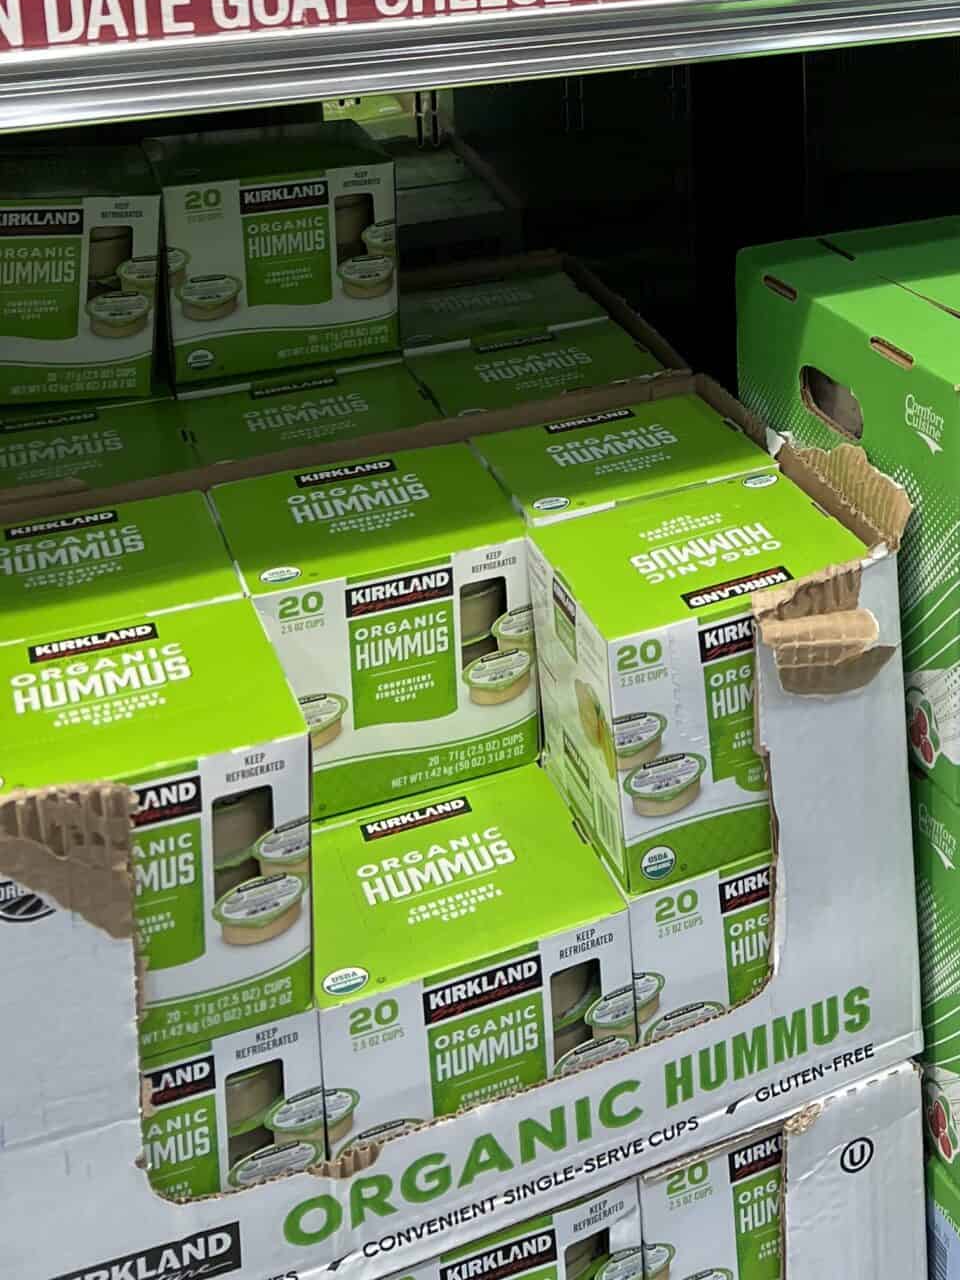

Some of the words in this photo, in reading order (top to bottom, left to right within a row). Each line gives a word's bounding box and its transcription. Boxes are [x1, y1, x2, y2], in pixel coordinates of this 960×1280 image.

[184, 189, 222, 210] 20
[244, 184, 325, 204] KIRKLAND
[248, 216, 324, 234] ORGANIC
[248, 230, 326, 259] HUMMUS
[291, 482, 430, 525] HUMMUS
[649, 539, 782, 585] ORGANIC
[278, 590, 324, 620] 20
[351, 571, 450, 605] KIRKLAND
[689, 570, 788, 607] KIRKLAND
[34, 625, 153, 657] KIRKLAND
[355, 610, 447, 641] ORGANIC
[10, 642, 183, 688] ORGANIC
[356, 626, 449, 671] HUMMUS
[616, 638, 663, 672] 20
[12, 655, 192, 715] HUMMUS
[226, 759, 286, 783] REFRIGERATED
[244, 752, 266, 766] KEEP
[366, 798, 466, 835] KIRKLAND
[357, 825, 504, 879] ORGANIC
[361, 840, 516, 906] HUMMUS
[655, 888, 698, 920] 20
[559, 932, 614, 960] REFRIGERATED
[576, 928, 595, 944] KEEP
[429, 960, 538, 1011] KIRKLAND
[349, 998, 399, 1035] 20
[434, 1005, 537, 1050] ORGANIC
[436, 1022, 538, 1082] HUMMUS
[755, 1043, 875, 1104] GLUTEN-FREE
[282, 1079, 644, 1248] ORGANIC
[664, 985, 872, 1111] HUMMUS
[361, 1195, 499, 1258] CONVENIENT
[502, 1137, 645, 1206] SINGLE-SERVE
[648, 1115, 700, 1149] CUPS
